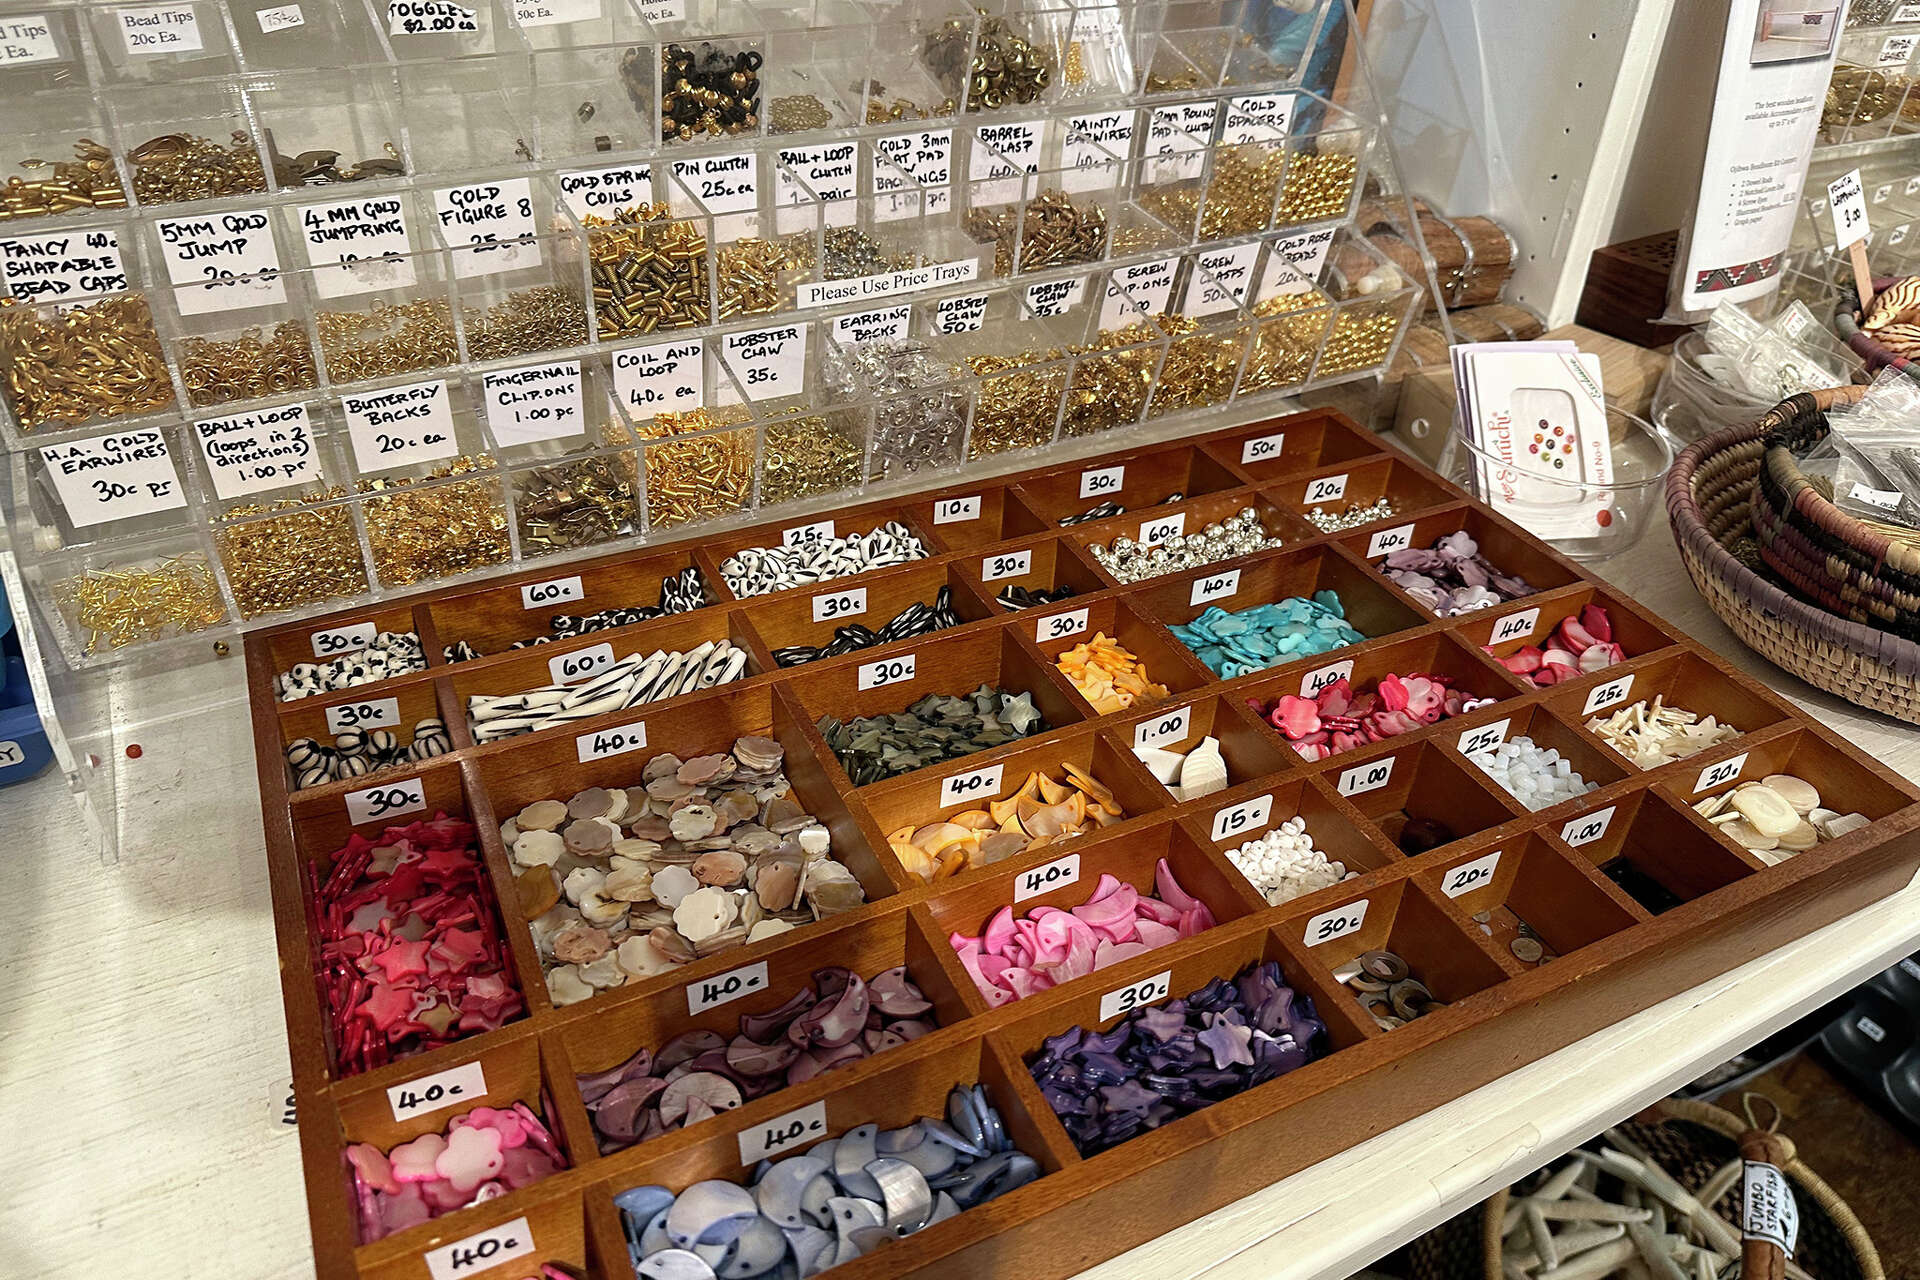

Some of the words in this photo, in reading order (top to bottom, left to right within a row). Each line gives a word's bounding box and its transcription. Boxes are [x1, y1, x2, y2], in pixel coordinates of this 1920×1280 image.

[124, 14, 160, 28] Bead
[167, 11, 194, 26] Tips
[517, 11, 535, 20] 50c
[538, 9, 553, 17] Ea.
[661, 10, 675, 19] Ea.
[10, 24, 47, 40] Tips
[403, 17, 455, 33] $2.00
[458, 21, 477, 30] ea
[130, 33, 157, 45] 20c
[160, 31, 182, 43] Ea.
[6, 45, 33, 58] Ea.
[1241, 99, 1276, 113] GOLD
[1073, 115, 1120, 131] DAINTY
[1152, 126, 1171, 138] PAD
[880, 139, 911, 154] GOLD
[921, 133, 950, 148] 3mm
[981, 126, 1033, 142] BARREL
[824, 146, 854, 162] LOOP
[916, 150, 944, 163] PAD
[674, 162, 700, 176] PIN
[706, 157, 749, 174] CLUTCH
[810, 164, 852, 179] CLUTCH
[561, 176, 599, 193] GOLD
[702, 181, 734, 198] 25c
[738, 183, 754, 192] ea
[449, 186, 500, 208] GOLD
[585, 189, 633, 206] COILS
[304, 210, 324, 228] 4
[328, 205, 360, 223] MM
[363, 201, 400, 219] GOLD
[439, 204, 507, 226] FIGURE
[517, 198, 532, 217] 8
[162, 221, 215, 242] 5MM
[222, 214, 268, 233] GOLD
[309, 219, 404, 244] JUMPRING
[1, 239, 70, 258] FANCY
[87, 234, 117, 248] 40c
[178, 238, 248, 260] JUMP
[1277, 239, 1305, 252] GOLD
[1307, 231, 1332, 245] ROSE
[6, 256, 116, 277] SHAPABLE
[1127, 262, 1168, 279] SCREW
[1202, 255, 1235, 269] SCREW
[10, 279, 71, 300] BEAD
[80, 274, 128, 292] CAPS
[811, 285, 858, 302] Please
[862, 279, 889, 294] Use
[894, 272, 928, 289] Price
[933, 264, 970, 282] Trays
[1037, 289, 1069, 303] CLAW
[840, 308, 909, 330] EARRING
[945, 308, 983, 322] CLAW
[729, 328, 798, 348] LOBSTER
[852, 324, 898, 342] BACKS
[617, 354, 658, 368] COIL
[666, 346, 700, 360] AND
[741, 343, 784, 360] CLAW
[484, 365, 580, 389] FINGERNAIL
[639, 362, 677, 377] LOOP
[747, 368, 778, 384] 35c
[346, 385, 439, 414] BUTTERFLY
[631, 389, 664, 405] 40c
[675, 386, 696, 398] ea
[257, 407, 303, 425] LOOP
[364, 404, 432, 426] BACKS
[514, 408, 550, 422] 1.00
[44, 447, 91, 462] H.A.
[103, 432, 158, 452] GOLD
[206, 435, 257, 458] (loops
[269, 430, 286, 443] in
[291, 427, 307, 441] 2
[376, 434, 417, 454] 20c
[423, 433, 447, 445] ea
[1250, 441, 1275, 457] 50c
[61, 442, 166, 475] EARWIRES
[216, 439, 310, 467] directions)
[239, 465, 276, 481] 1.00
[284, 461, 306, 478] pr
[92, 480, 137, 503] 30c
[146, 480, 171, 498] pr
[1089, 475, 1116, 491] 30c
[1313, 482, 1342, 500] 20c
[943, 501, 970, 517] 10c
[791, 527, 823, 547] 25c
[1149, 524, 1179, 542] 60c
[1378, 534, 1405, 549] 40c
[993, 557, 1025, 576] 30c
[530, 584, 571, 602] 60c
[1203, 578, 1233, 595] 40c
[822, 597, 860, 617] 30c
[1050, 618, 1084, 637] 30c
[1500, 619, 1532, 638] 40c
[318, 634, 364, 652] 30c
[563, 655, 606, 676] 60c
[873, 662, 915, 685] 30c
[1594, 685, 1623, 706] 25c
[337, 705, 384, 726] 30c
[1142, 716, 1183, 743] 1.00
[593, 734, 640, 753] 40c
[1464, 729, 1499, 753] 25c
[951, 775, 994, 794] 40c
[1350, 766, 1387, 791] 1.00
[366, 789, 421, 816] 30c
[1221, 809, 1260, 834] 15c
[1566, 821, 1602, 844] 1.00
[1026, 866, 1071, 891] 40c
[1450, 867, 1489, 890] 20c
[1318, 917, 1359, 939] 30c
[702, 976, 760, 1003] 40c
[1119, 982, 1166, 1013] 30c
[398, 1084, 463, 1109] 40c
[764, 1120, 822, 1150] 40c
[1748, 1182, 1765, 1231] JUMBO
[1766, 1170, 1778, 1231] STARFISH
[451, 1237, 519, 1269] 40c
